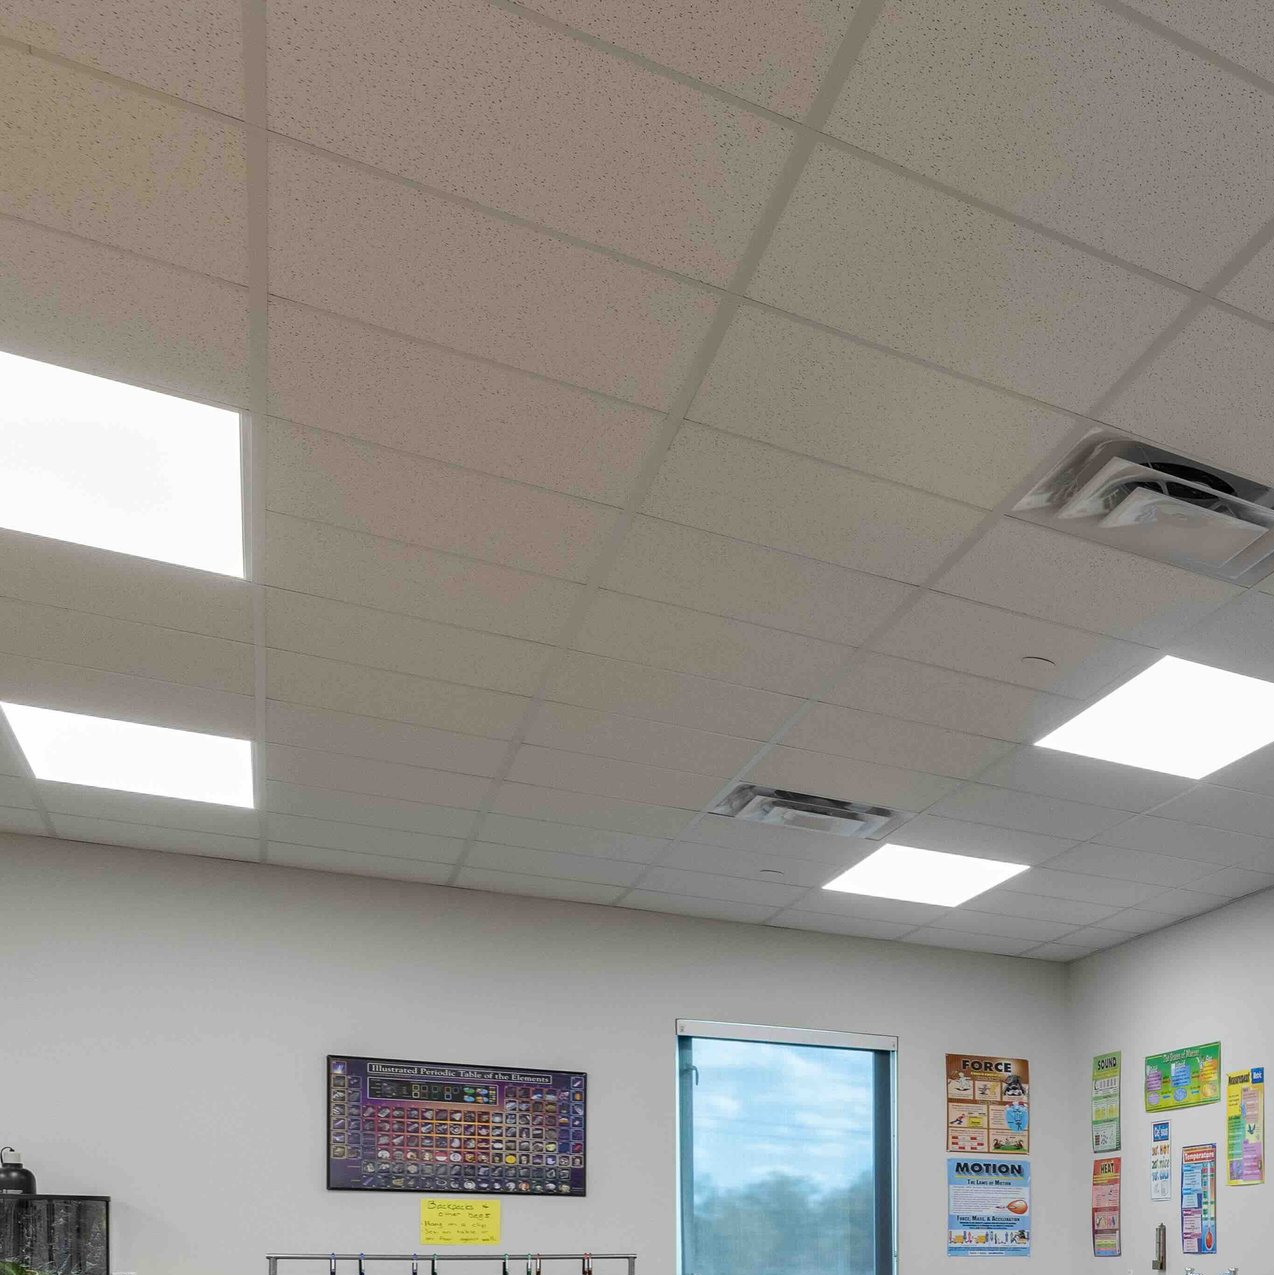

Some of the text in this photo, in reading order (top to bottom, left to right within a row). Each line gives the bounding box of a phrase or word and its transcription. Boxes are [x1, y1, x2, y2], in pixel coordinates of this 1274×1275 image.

[962, 1059, 1012, 1073] FORCE
[1098, 1057, 1116, 1070] SOUND
[370, 1065, 417, 1074] Illustrated
[420, 1068, 456, 1077] Periodic
[460, 1071, 481, 1079] Table
[512, 1074, 549, 1083] Elements
[1185, 1151, 1214, 1160] Temperature
[956, 1163, 1021, 1174] MOTION
[1101, 1163, 1114, 1174] HEAT
